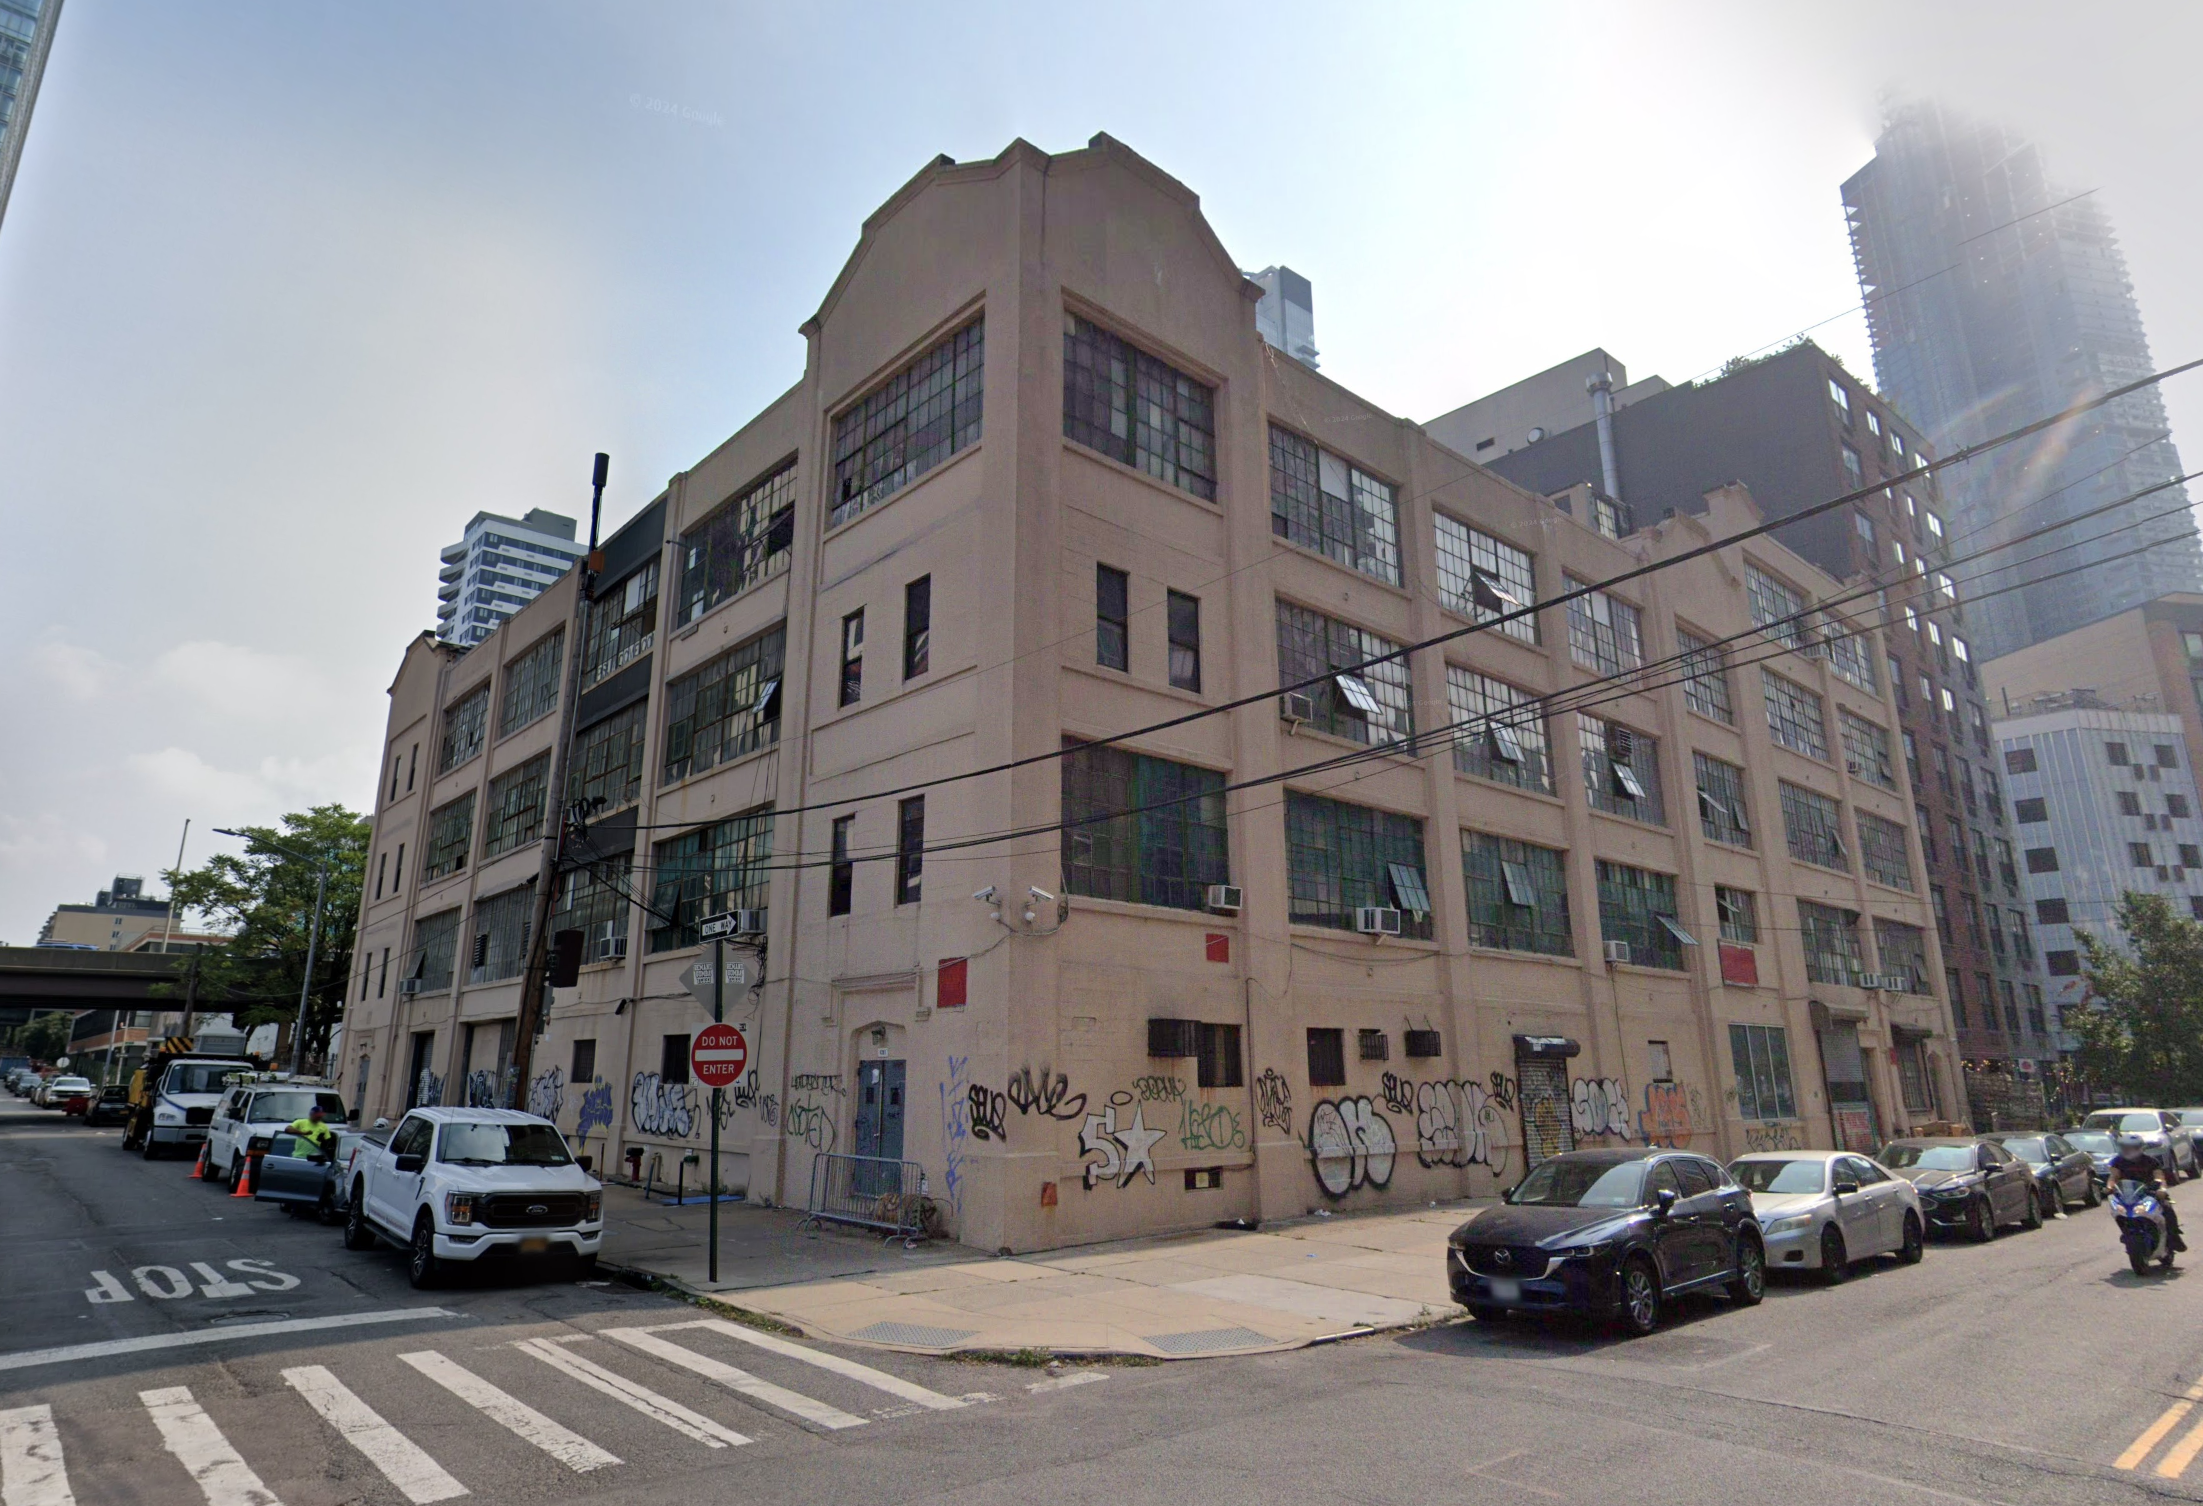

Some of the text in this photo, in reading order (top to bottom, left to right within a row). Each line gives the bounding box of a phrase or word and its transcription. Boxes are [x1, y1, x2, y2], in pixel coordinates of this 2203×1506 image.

[704, 919, 732, 934] ONE WAY
[701, 1035, 738, 1046] DO NOT
[703, 1064, 734, 1075] ENTER
[84, 1259, 301, 1304] STOP
